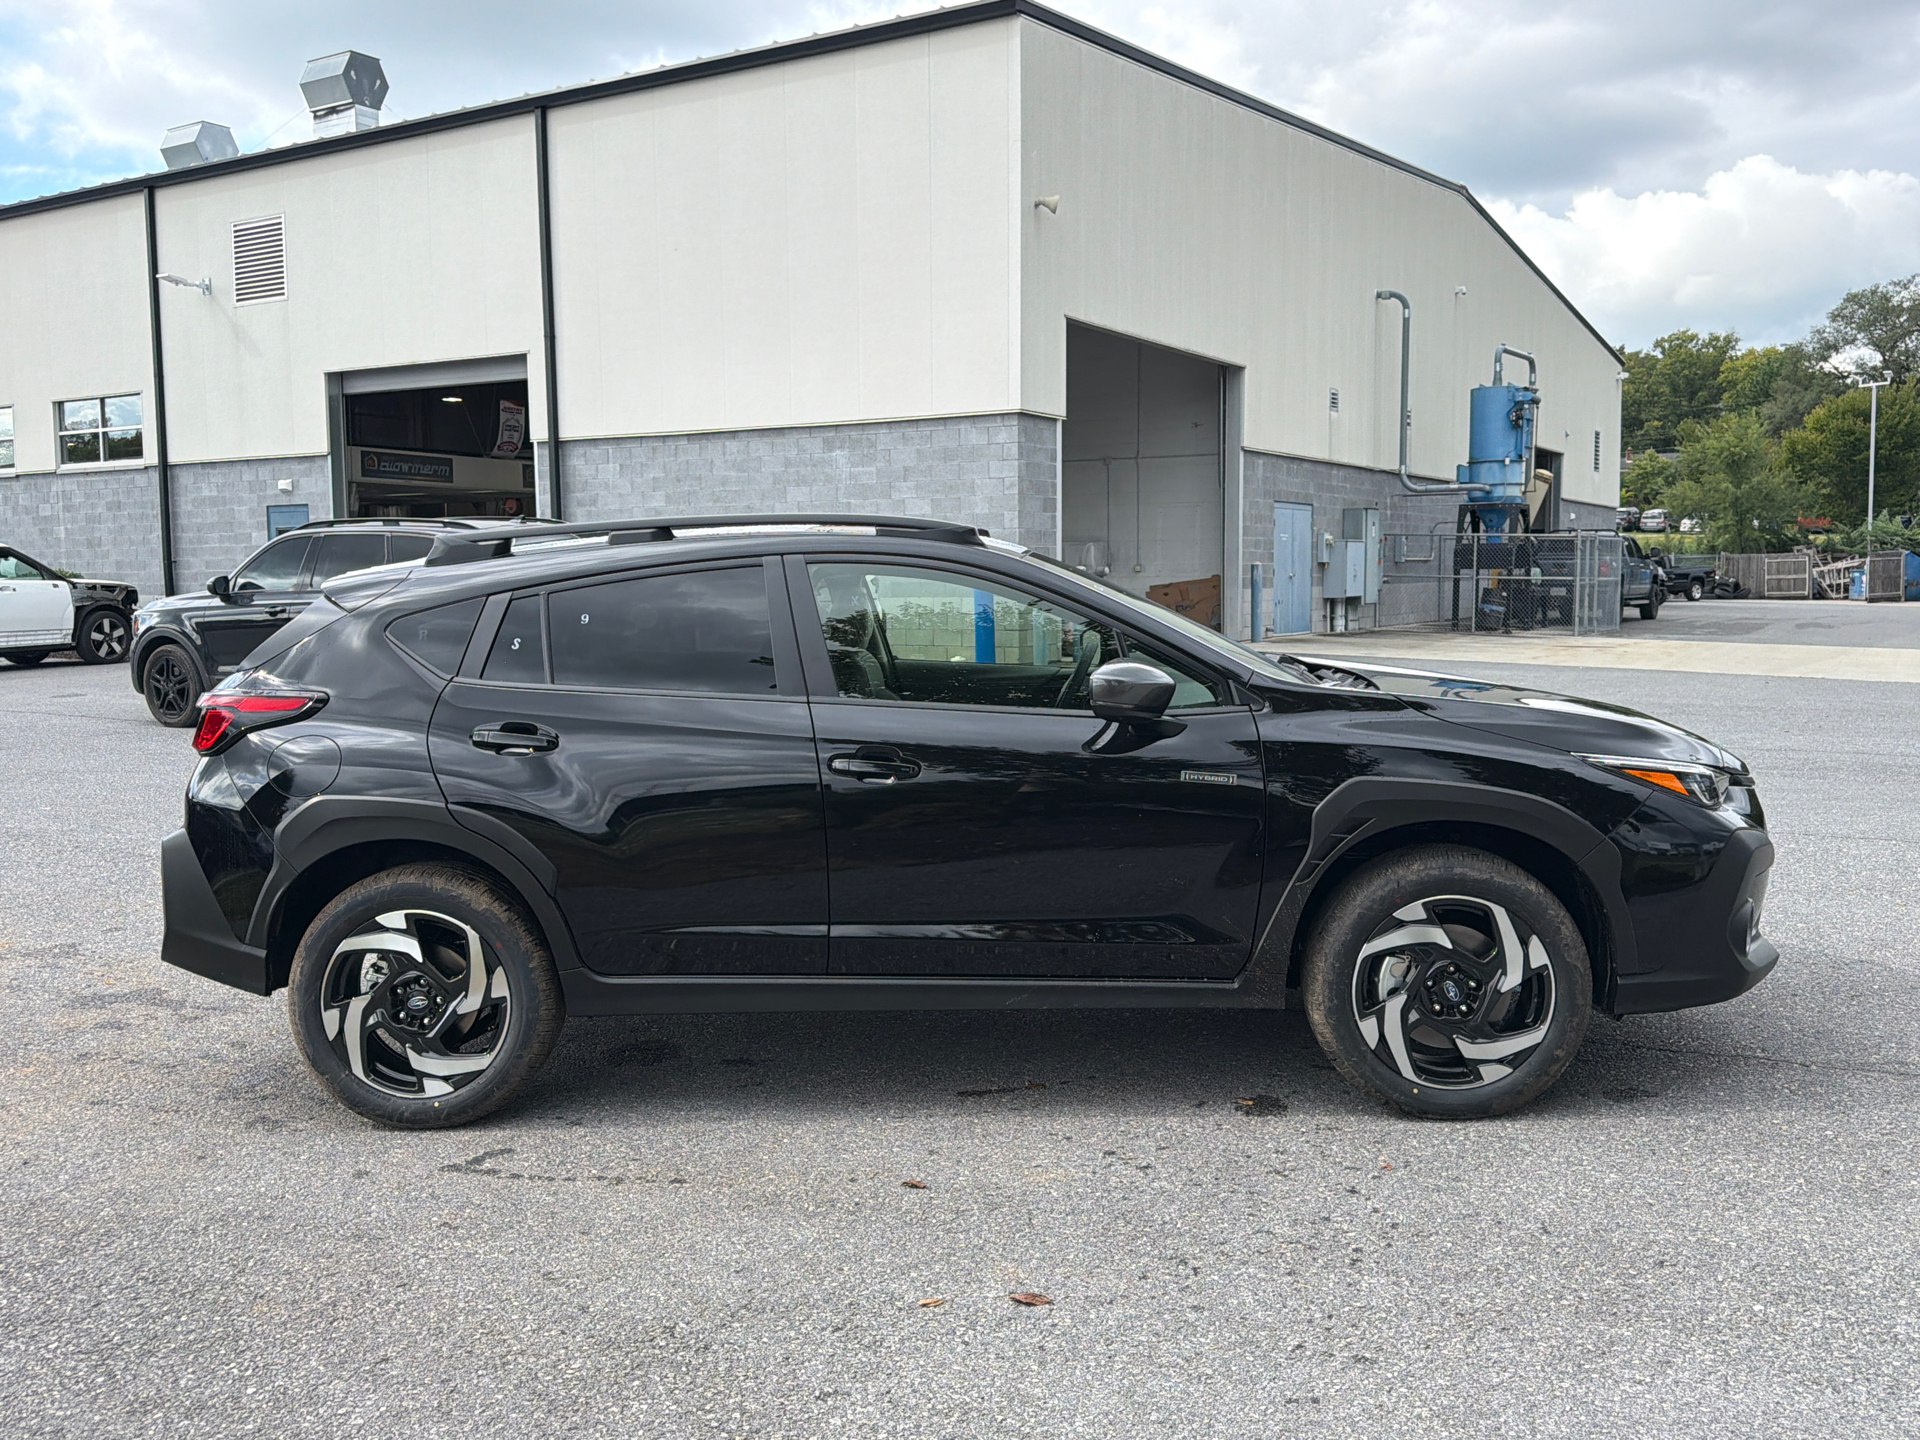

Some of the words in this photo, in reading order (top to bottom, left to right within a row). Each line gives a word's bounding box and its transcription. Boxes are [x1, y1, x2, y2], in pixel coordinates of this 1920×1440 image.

[580, 613, 590, 625] 9
[511, 637, 521, 650] S
[1190, 773, 1228, 783] HYBRID
